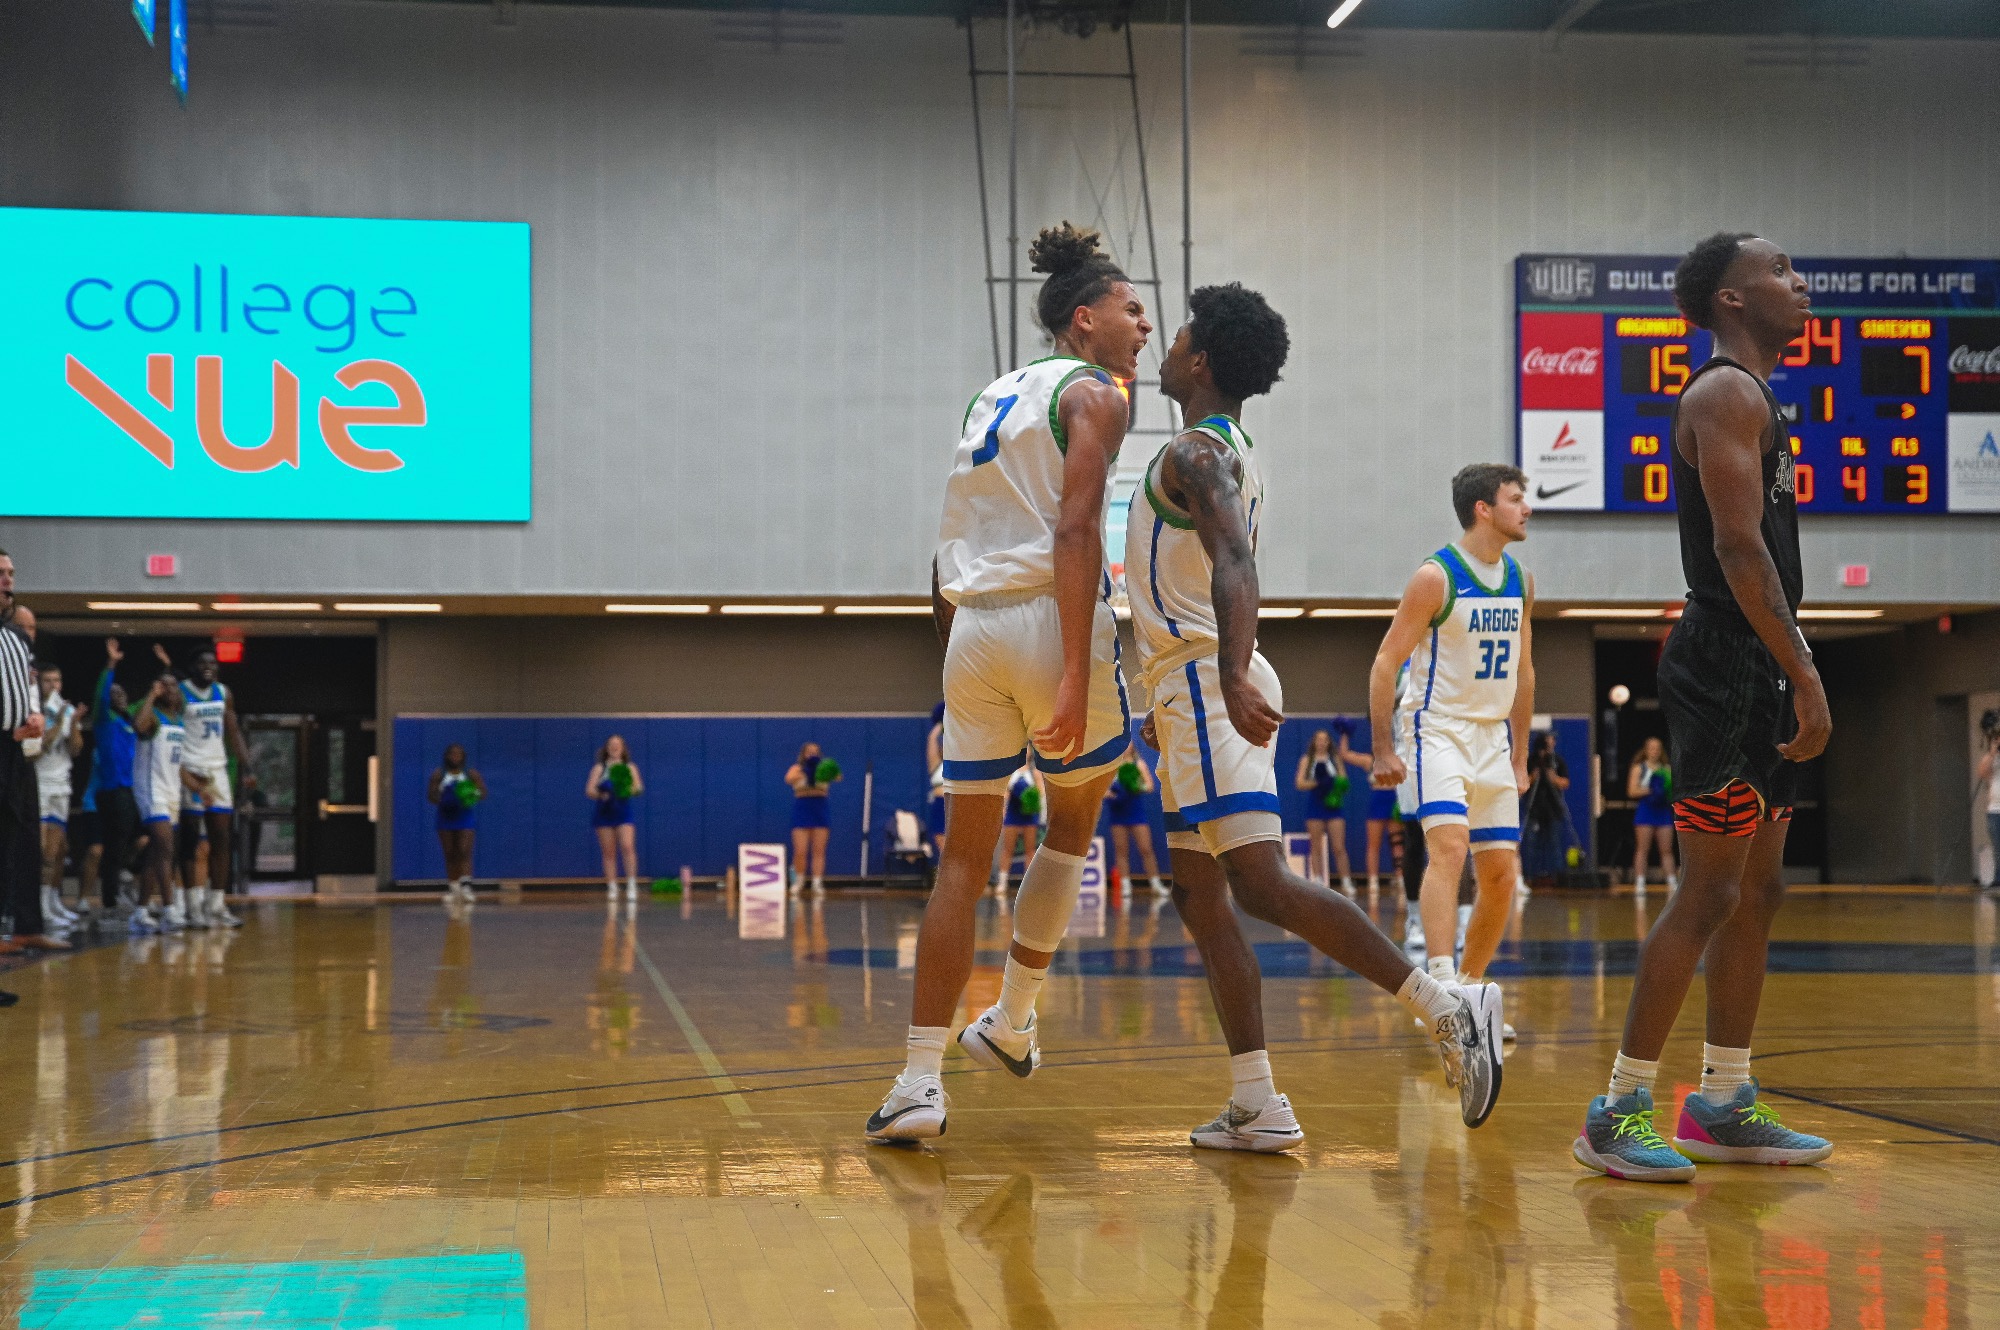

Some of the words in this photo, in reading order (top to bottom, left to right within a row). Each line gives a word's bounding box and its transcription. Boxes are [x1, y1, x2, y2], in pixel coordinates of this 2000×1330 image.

[1534, 261, 1595, 297] UWF
[1609, 270, 1676, 290] BUILD
[1800, 272, 1863, 293] IONS
[1869, 272, 1916, 293] FOR
[1922, 272, 1976, 293] LIFE
[65, 263, 418, 353] college
[1650, 344, 1691, 396] 15
[1903, 345, 1930, 395] 7
[1823, 386, 1833, 423] 1
[1630, 435, 1659, 455] FLS
[1891, 437, 1919, 457] FLS
[1644, 463, 1668, 503] 0
[1842, 466, 1867, 502] 4
[1906, 464, 1929, 504] 3
[1468, 608, 1520, 632] ARGOS
[1474, 639, 1511, 680] 32
